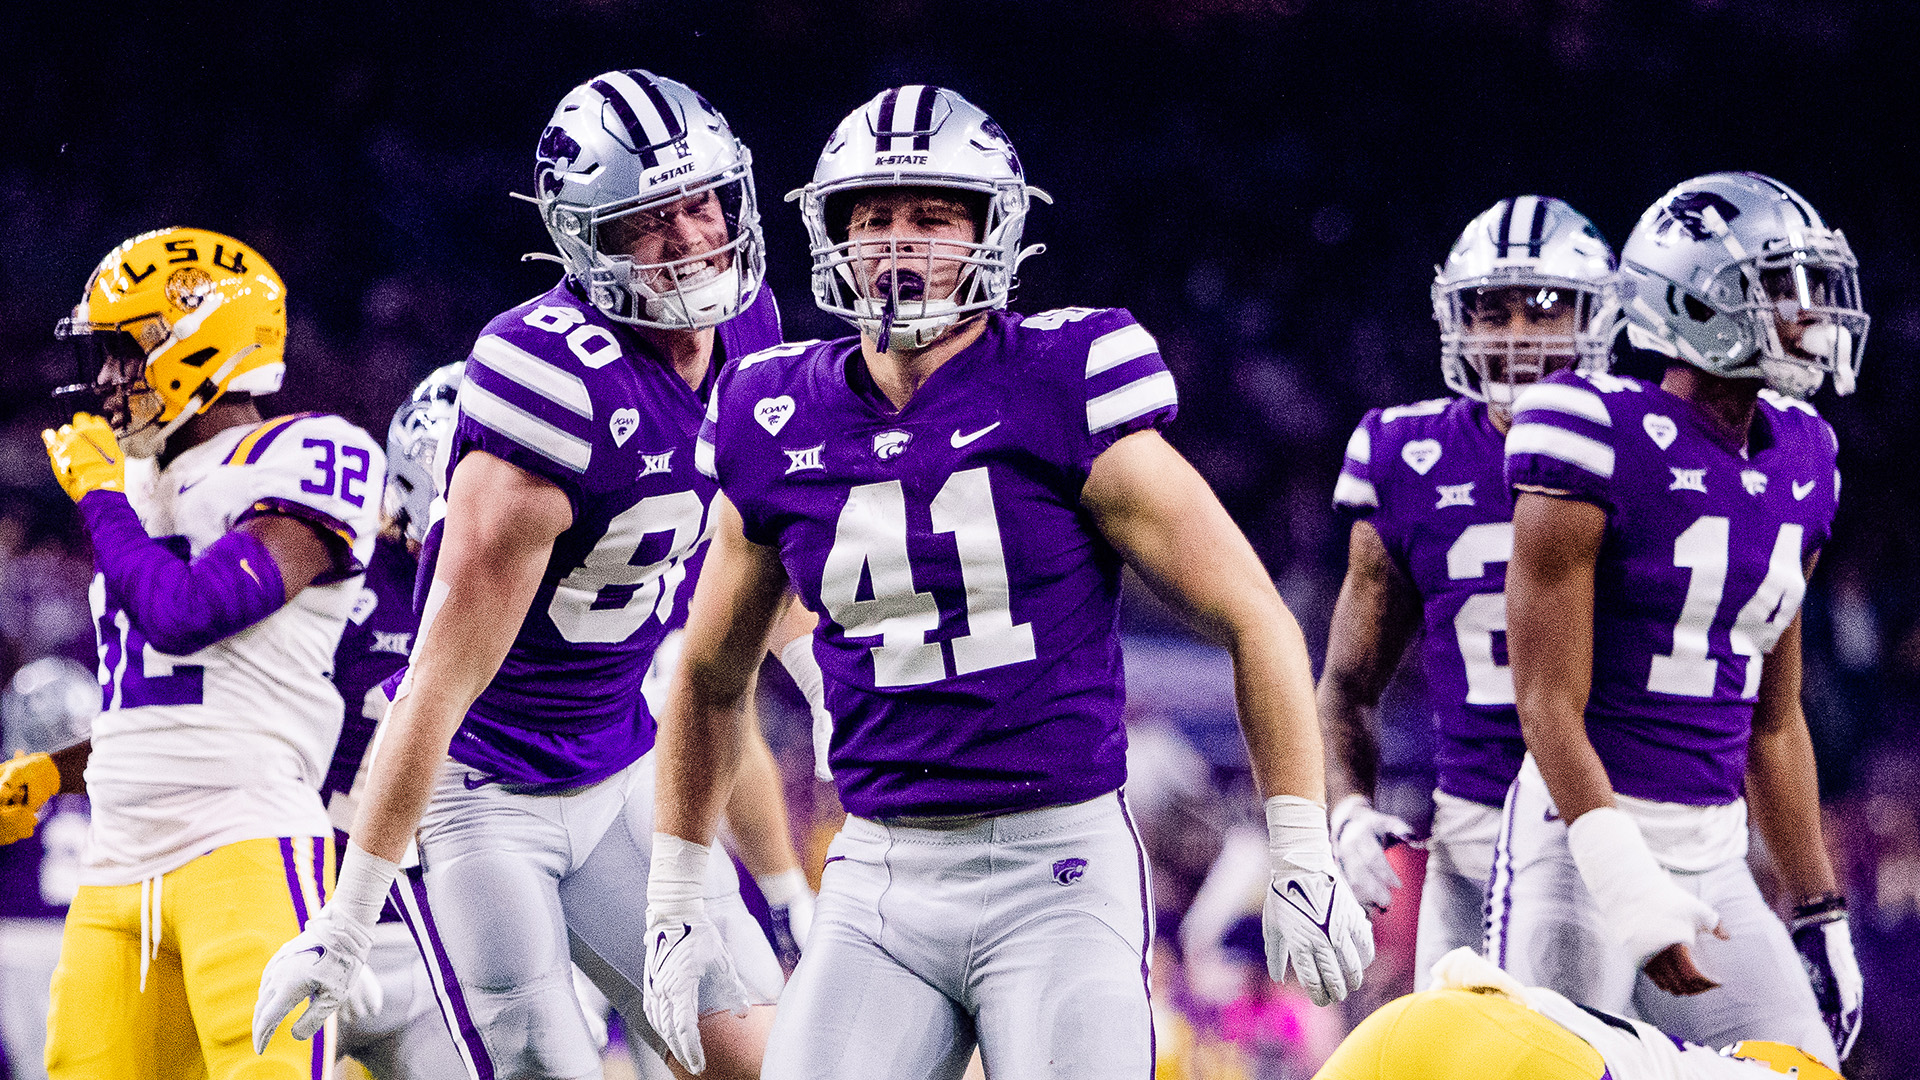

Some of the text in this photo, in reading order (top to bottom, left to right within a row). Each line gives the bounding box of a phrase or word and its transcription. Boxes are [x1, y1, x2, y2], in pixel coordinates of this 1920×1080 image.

[648, 161, 696, 186] K-STATE
[874, 154, 929, 166] K-STATE
[122, 239, 248, 285] LSU
[522, 304, 624, 370] 80
[760, 404, 788, 416] JOAN
[301, 438, 371, 508] 32
[636, 446, 677, 482] XII
[782, 440, 828, 476] XII
[820, 466, 1037, 688] 41
[1647, 516, 1806, 699] 14
